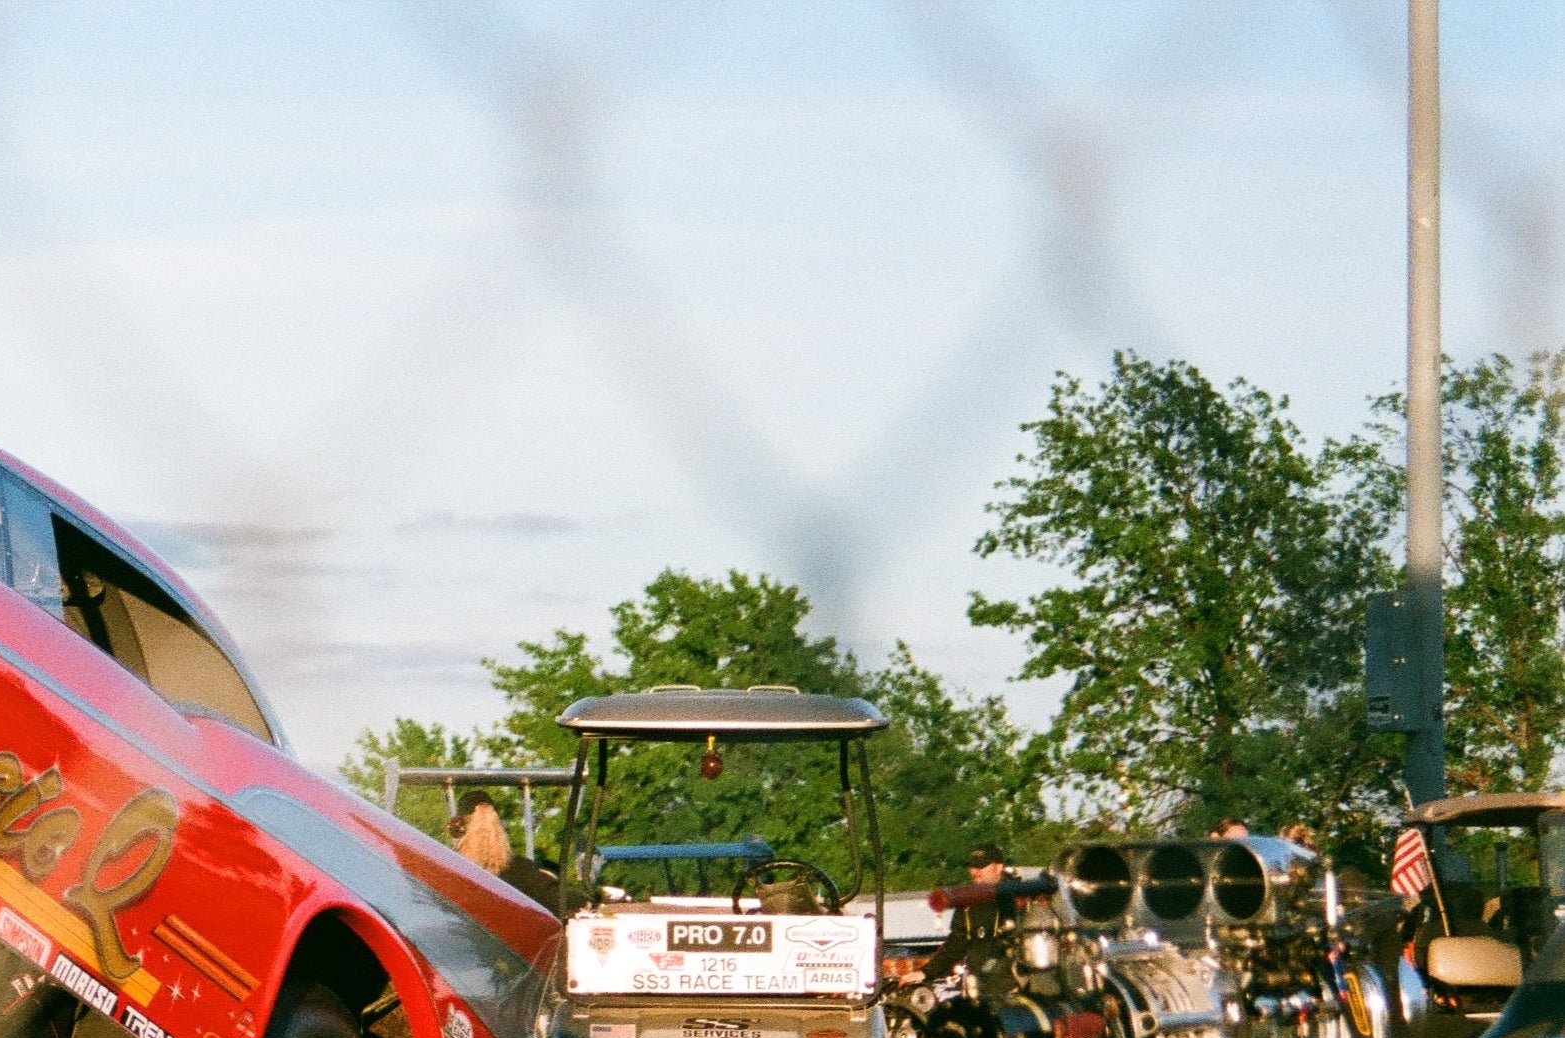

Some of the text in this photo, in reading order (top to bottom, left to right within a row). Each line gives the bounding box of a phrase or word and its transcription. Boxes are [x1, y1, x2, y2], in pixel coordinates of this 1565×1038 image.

[64, 786, 180, 980] Q
[673, 925, 766, 945] PRO 7.0
[701, 957, 738, 972] 1216
[50, 953, 119, 1017] MOROSO
[632, 974, 798, 990] SS3 RACE TEAM
[809, 973, 853, 984] ARIAS
[683, 1030, 762, 1038] SERVICES
